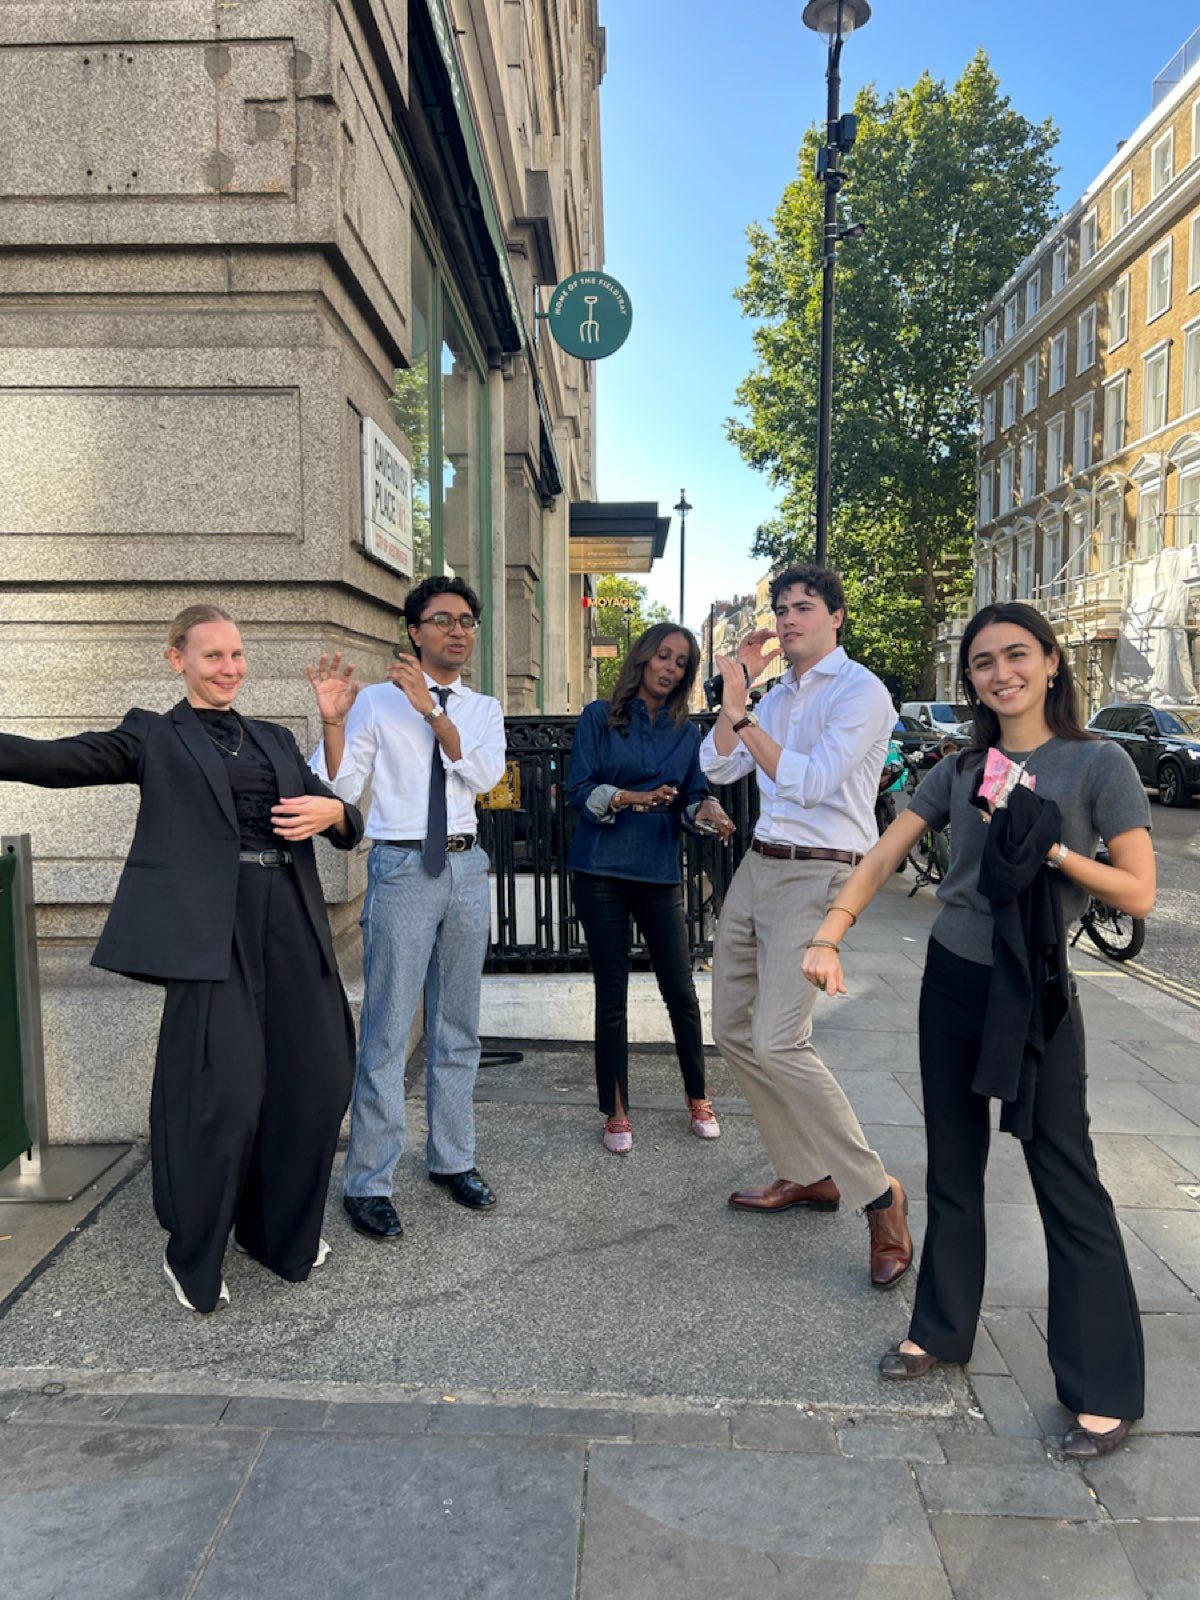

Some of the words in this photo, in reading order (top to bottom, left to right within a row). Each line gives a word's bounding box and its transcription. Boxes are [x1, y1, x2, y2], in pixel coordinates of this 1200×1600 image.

[555, 290, 568, 315] HOME
[567, 280, 578, 291] OF
[580, 277, 596, 285] THE
[375, 480, 396, 524] PLACE
